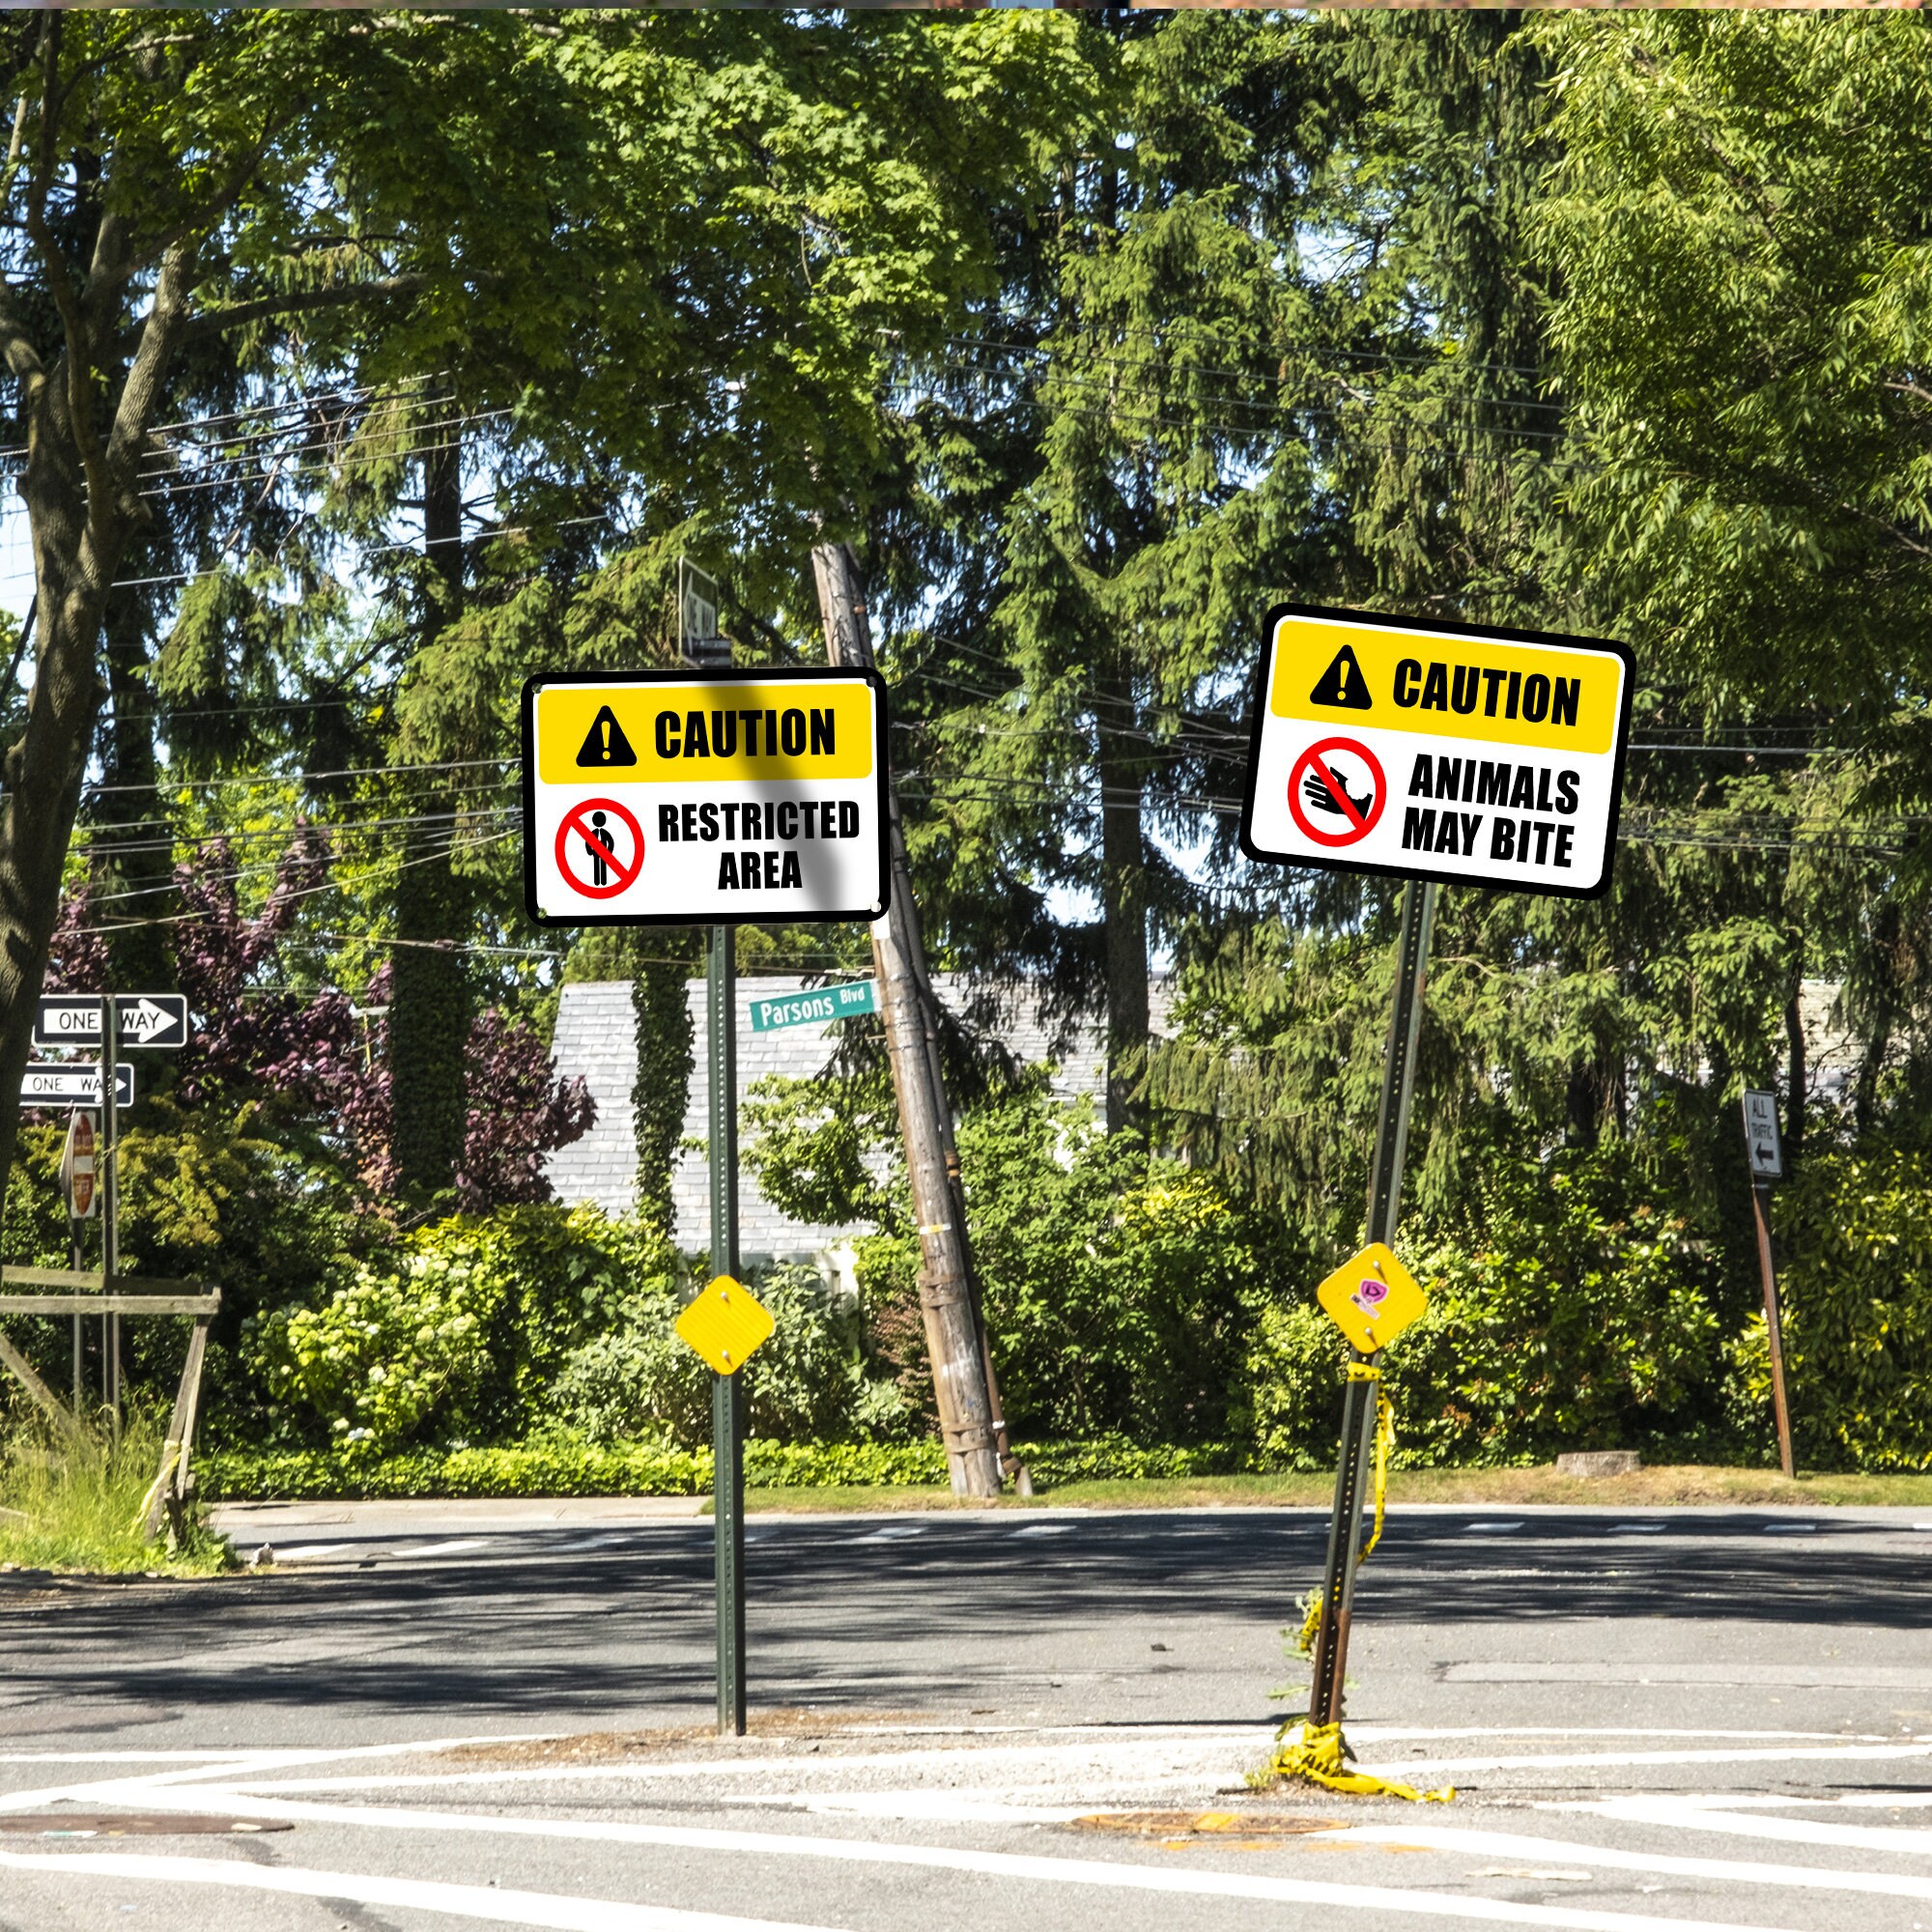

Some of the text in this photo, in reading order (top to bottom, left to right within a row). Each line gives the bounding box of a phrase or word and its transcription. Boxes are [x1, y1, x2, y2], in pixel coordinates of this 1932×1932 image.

[1392, 658, 1581, 726] CAUTION
[655, 708, 836, 759] CAUTION
[1407, 753, 1580, 814] ANIMALS
[658, 800, 860, 842] RESTRICTED
[1402, 806, 1576, 867] MAY BITE
[718, 850, 803, 890] AREA
[59, 1011, 160, 1030] ONE WAY
[760, 986, 866, 1026] Parsons Blvd
[33, 1077, 104, 1092] ONE WA
[1752, 1097, 1768, 1119] ALL
